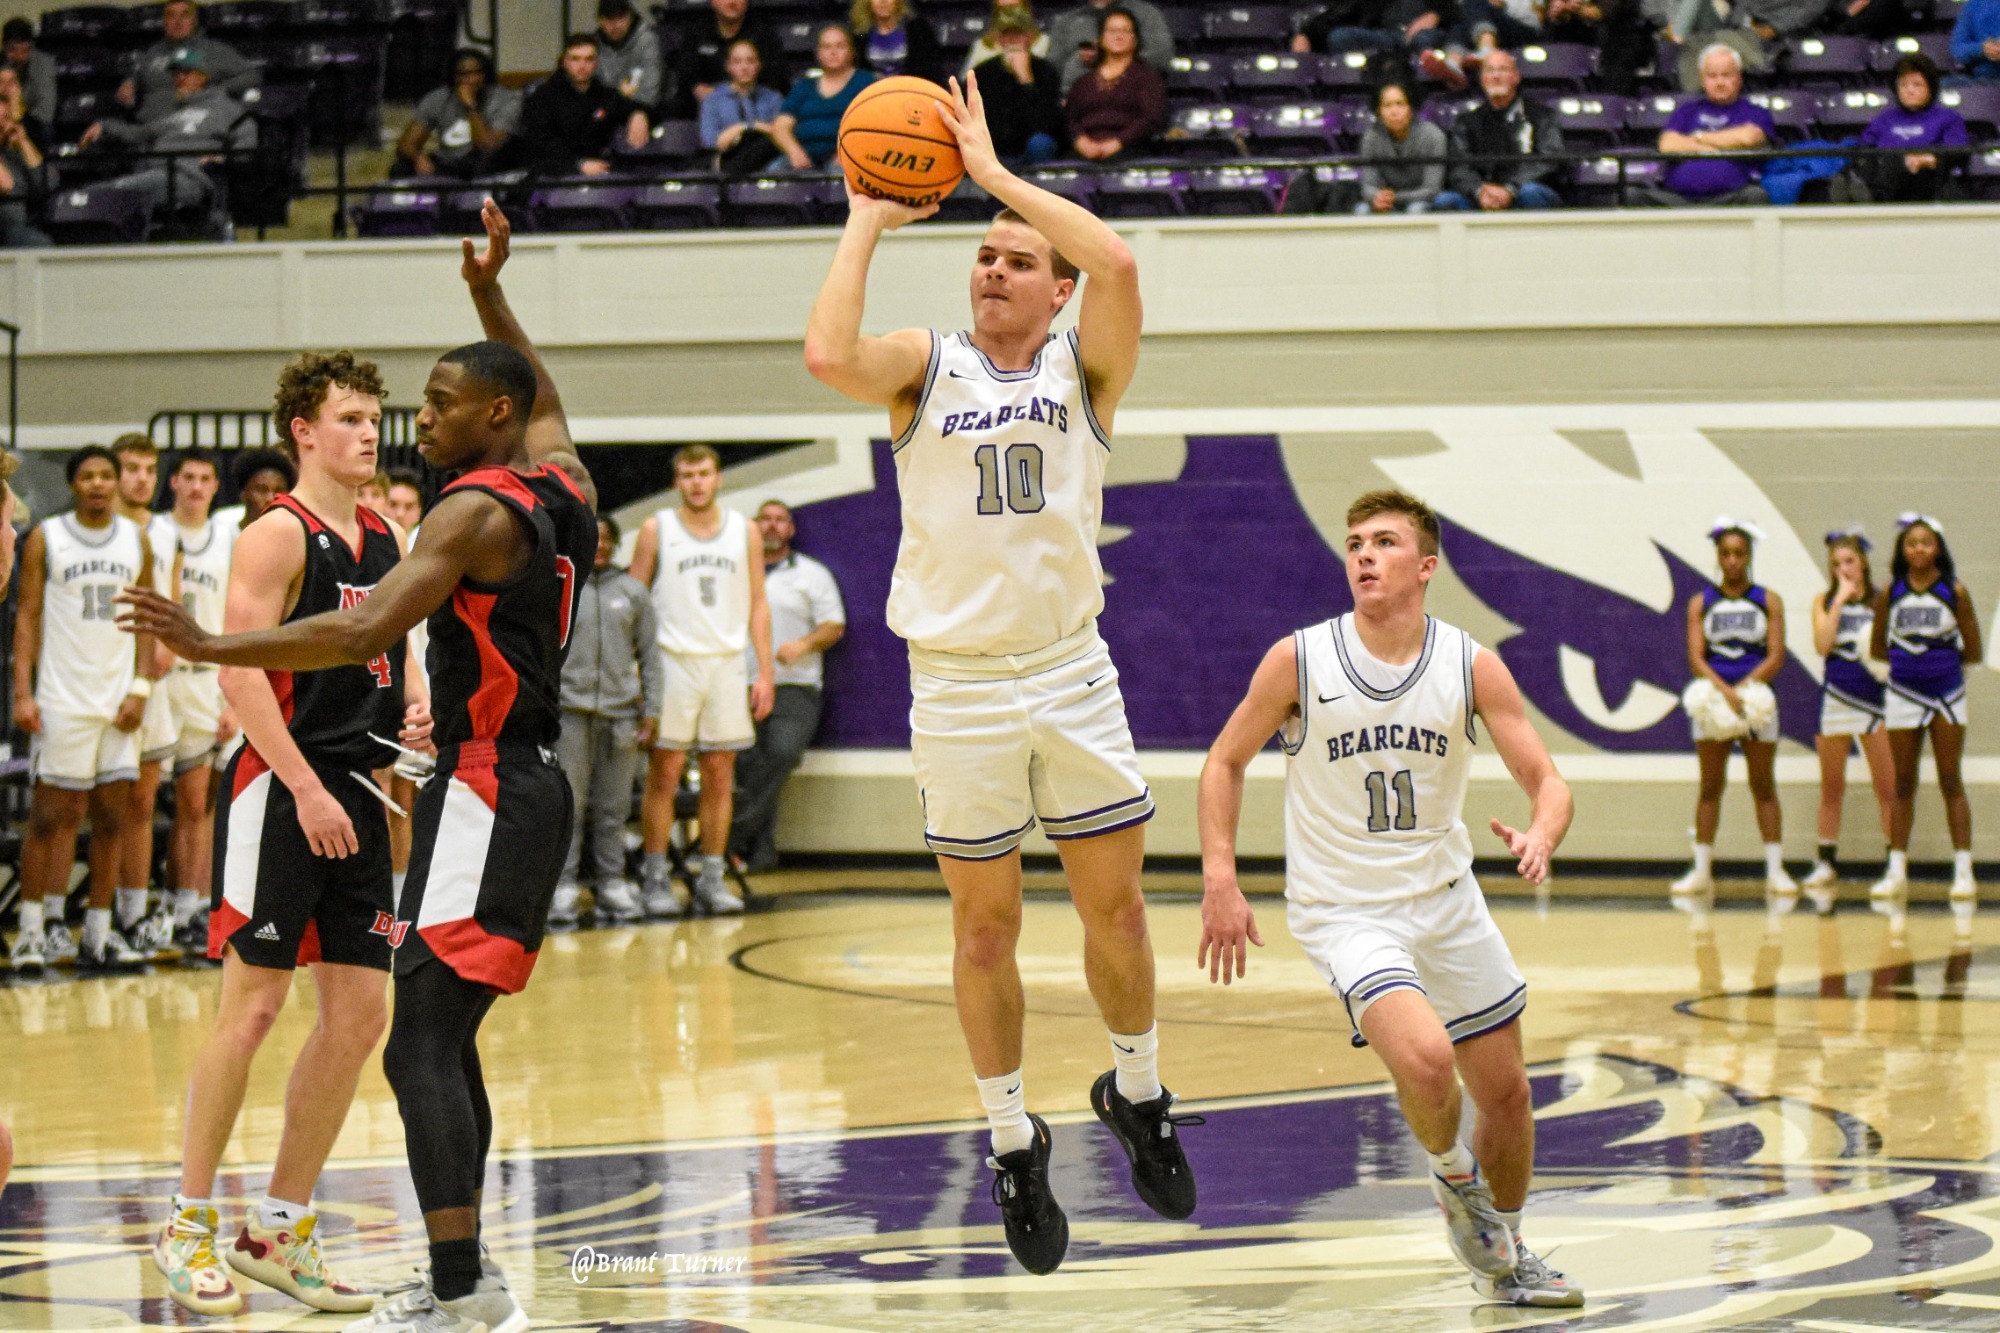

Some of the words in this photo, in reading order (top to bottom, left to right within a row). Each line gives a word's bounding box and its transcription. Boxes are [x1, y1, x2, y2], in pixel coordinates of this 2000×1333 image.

[882, 149, 935, 173] EVO
[942, 396, 1068, 438] BEARCATS
[974, 443, 1046, 515] 10
[81, 584, 118, 620] 15
[1326, 723, 1448, 762] BEARCATS
[1365, 769, 1417, 832] 11
[254, 931, 281, 942] adidas
